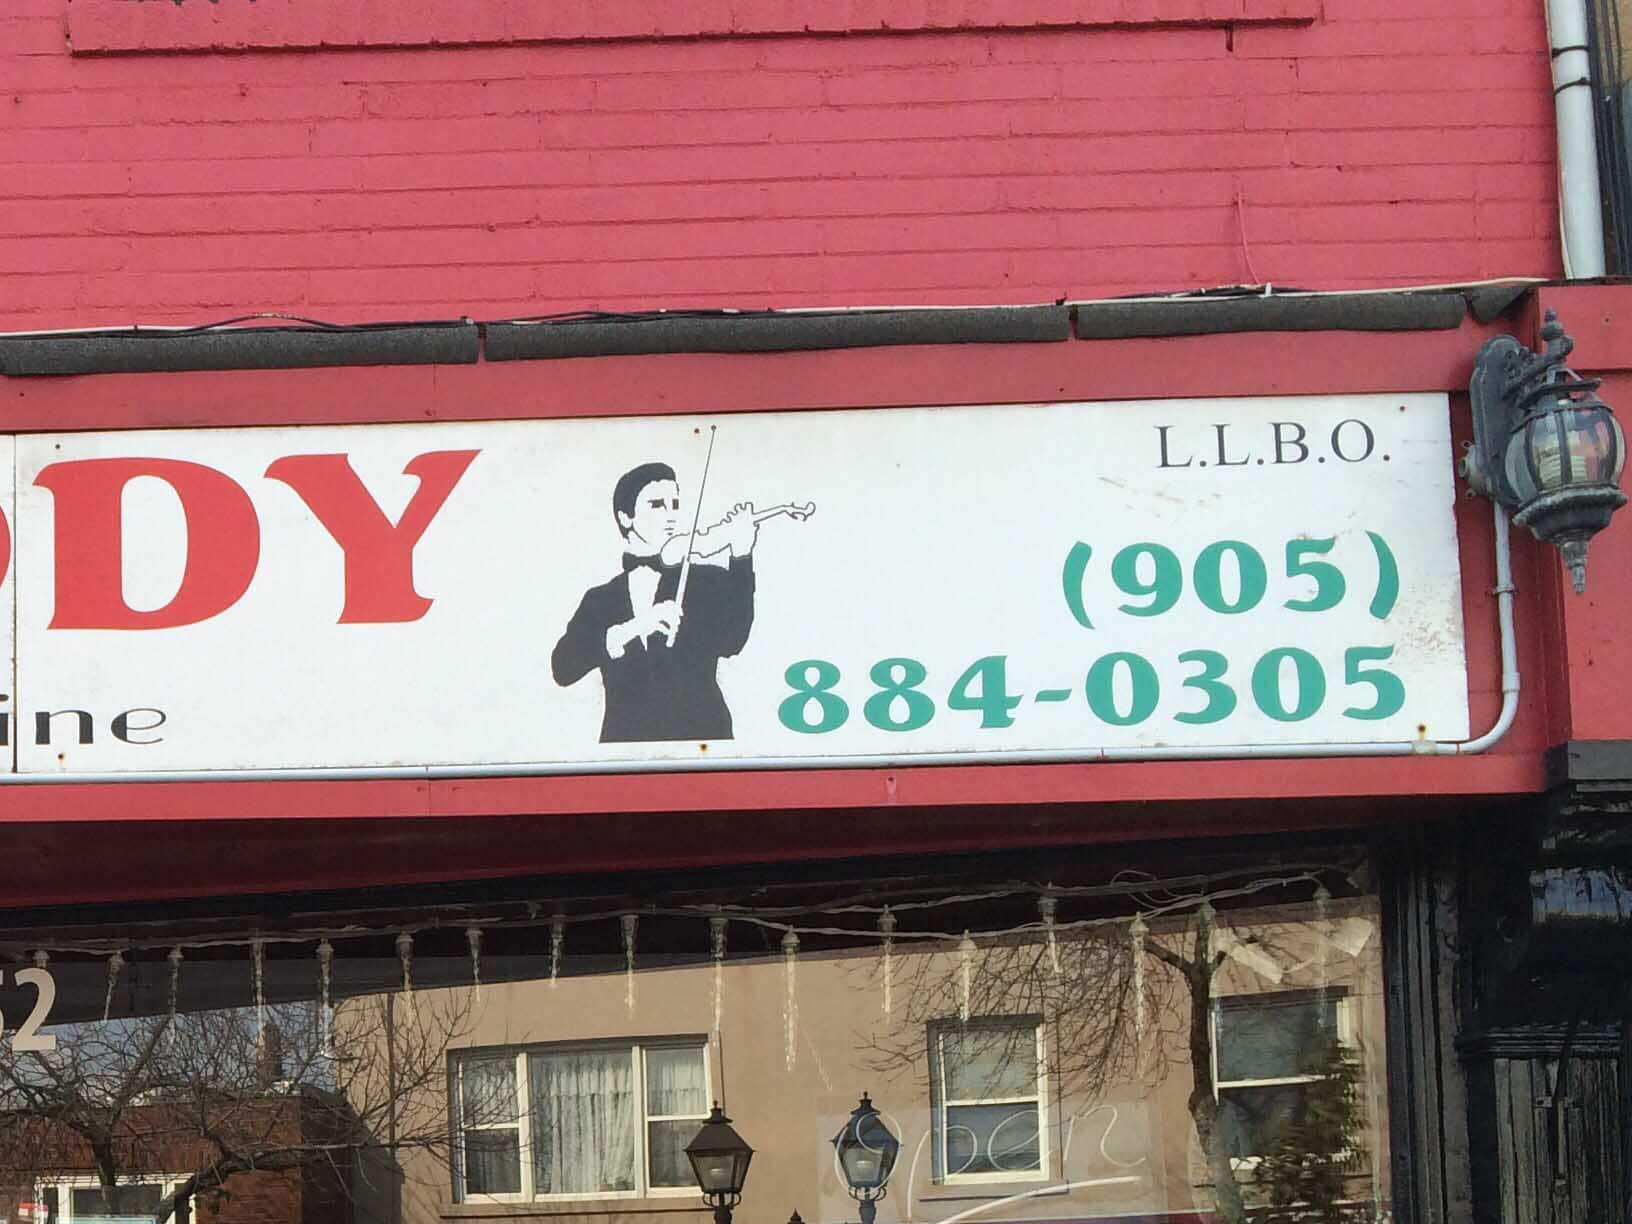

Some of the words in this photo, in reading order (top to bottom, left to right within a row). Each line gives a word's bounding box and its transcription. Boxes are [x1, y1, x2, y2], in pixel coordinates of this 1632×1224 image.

[1155, 418, 1391, 469] L.L.B.O.
[1061, 531, 1400, 631] (905)
[777, 646, 1407, 735] 884-0305
